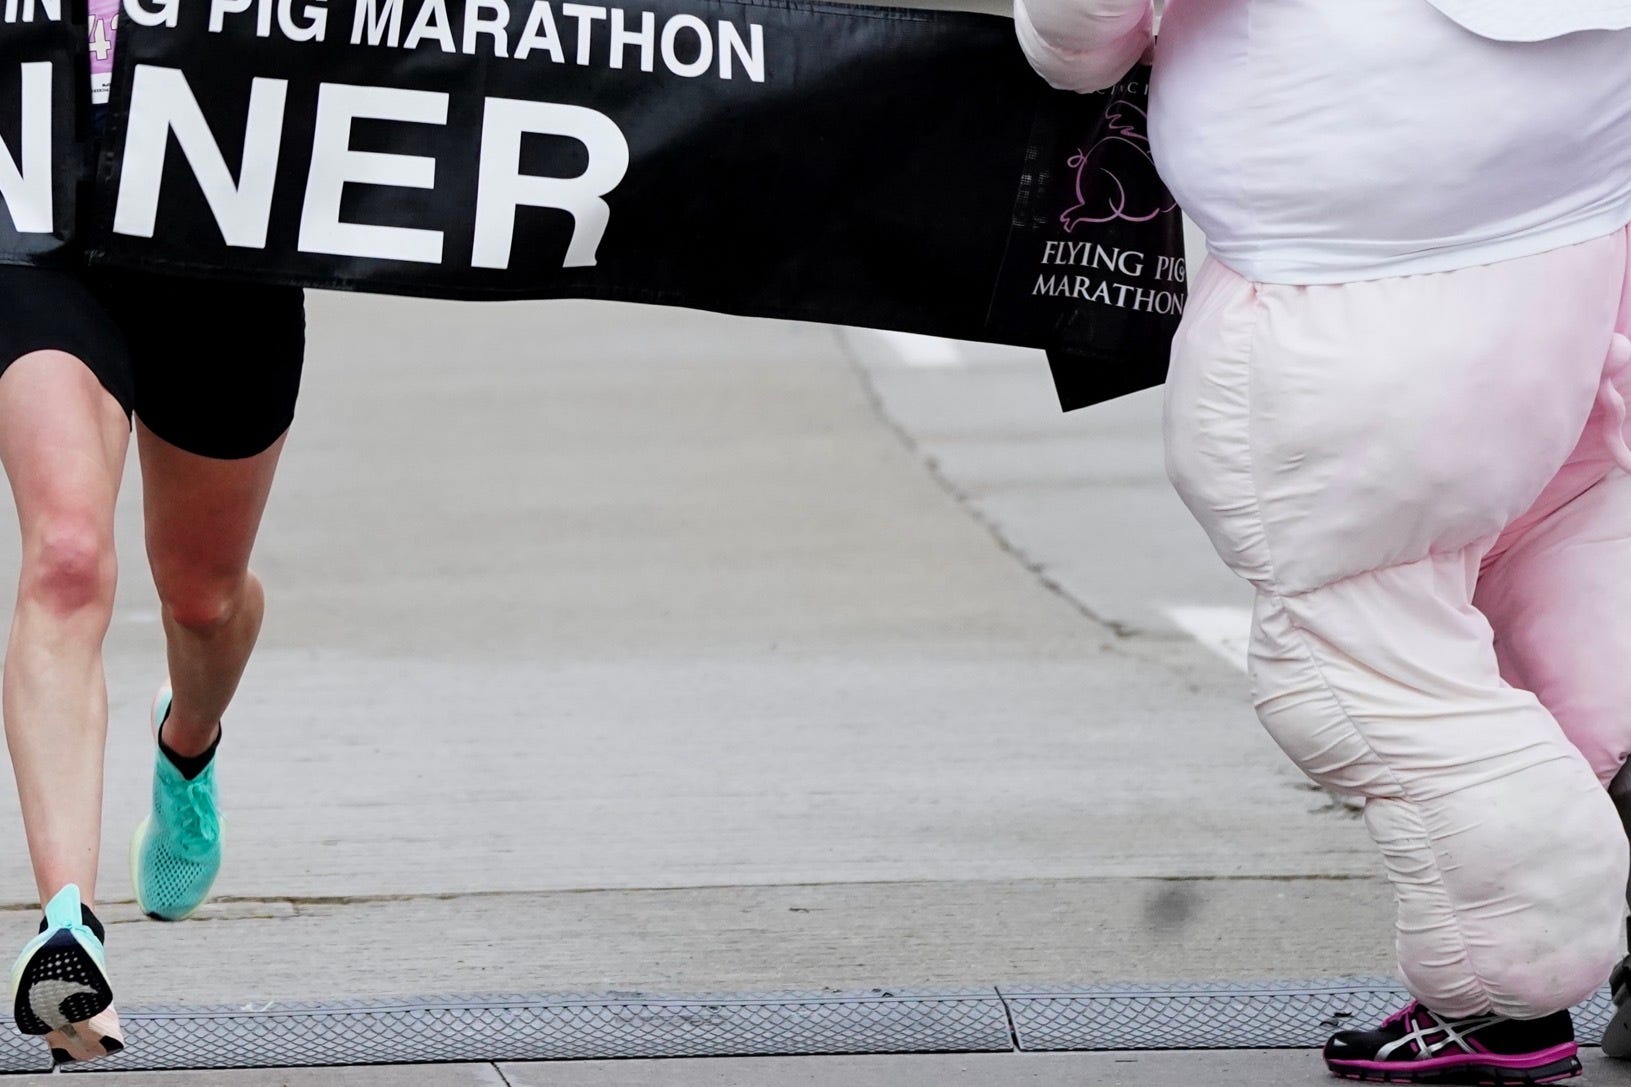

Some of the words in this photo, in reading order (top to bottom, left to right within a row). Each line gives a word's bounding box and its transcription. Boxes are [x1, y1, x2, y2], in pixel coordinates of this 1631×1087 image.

[1041, 240, 1144, 277] FLYING
[1155, 255, 1186, 283] PIG
[1032, 273, 1185, 316] MARATHON
